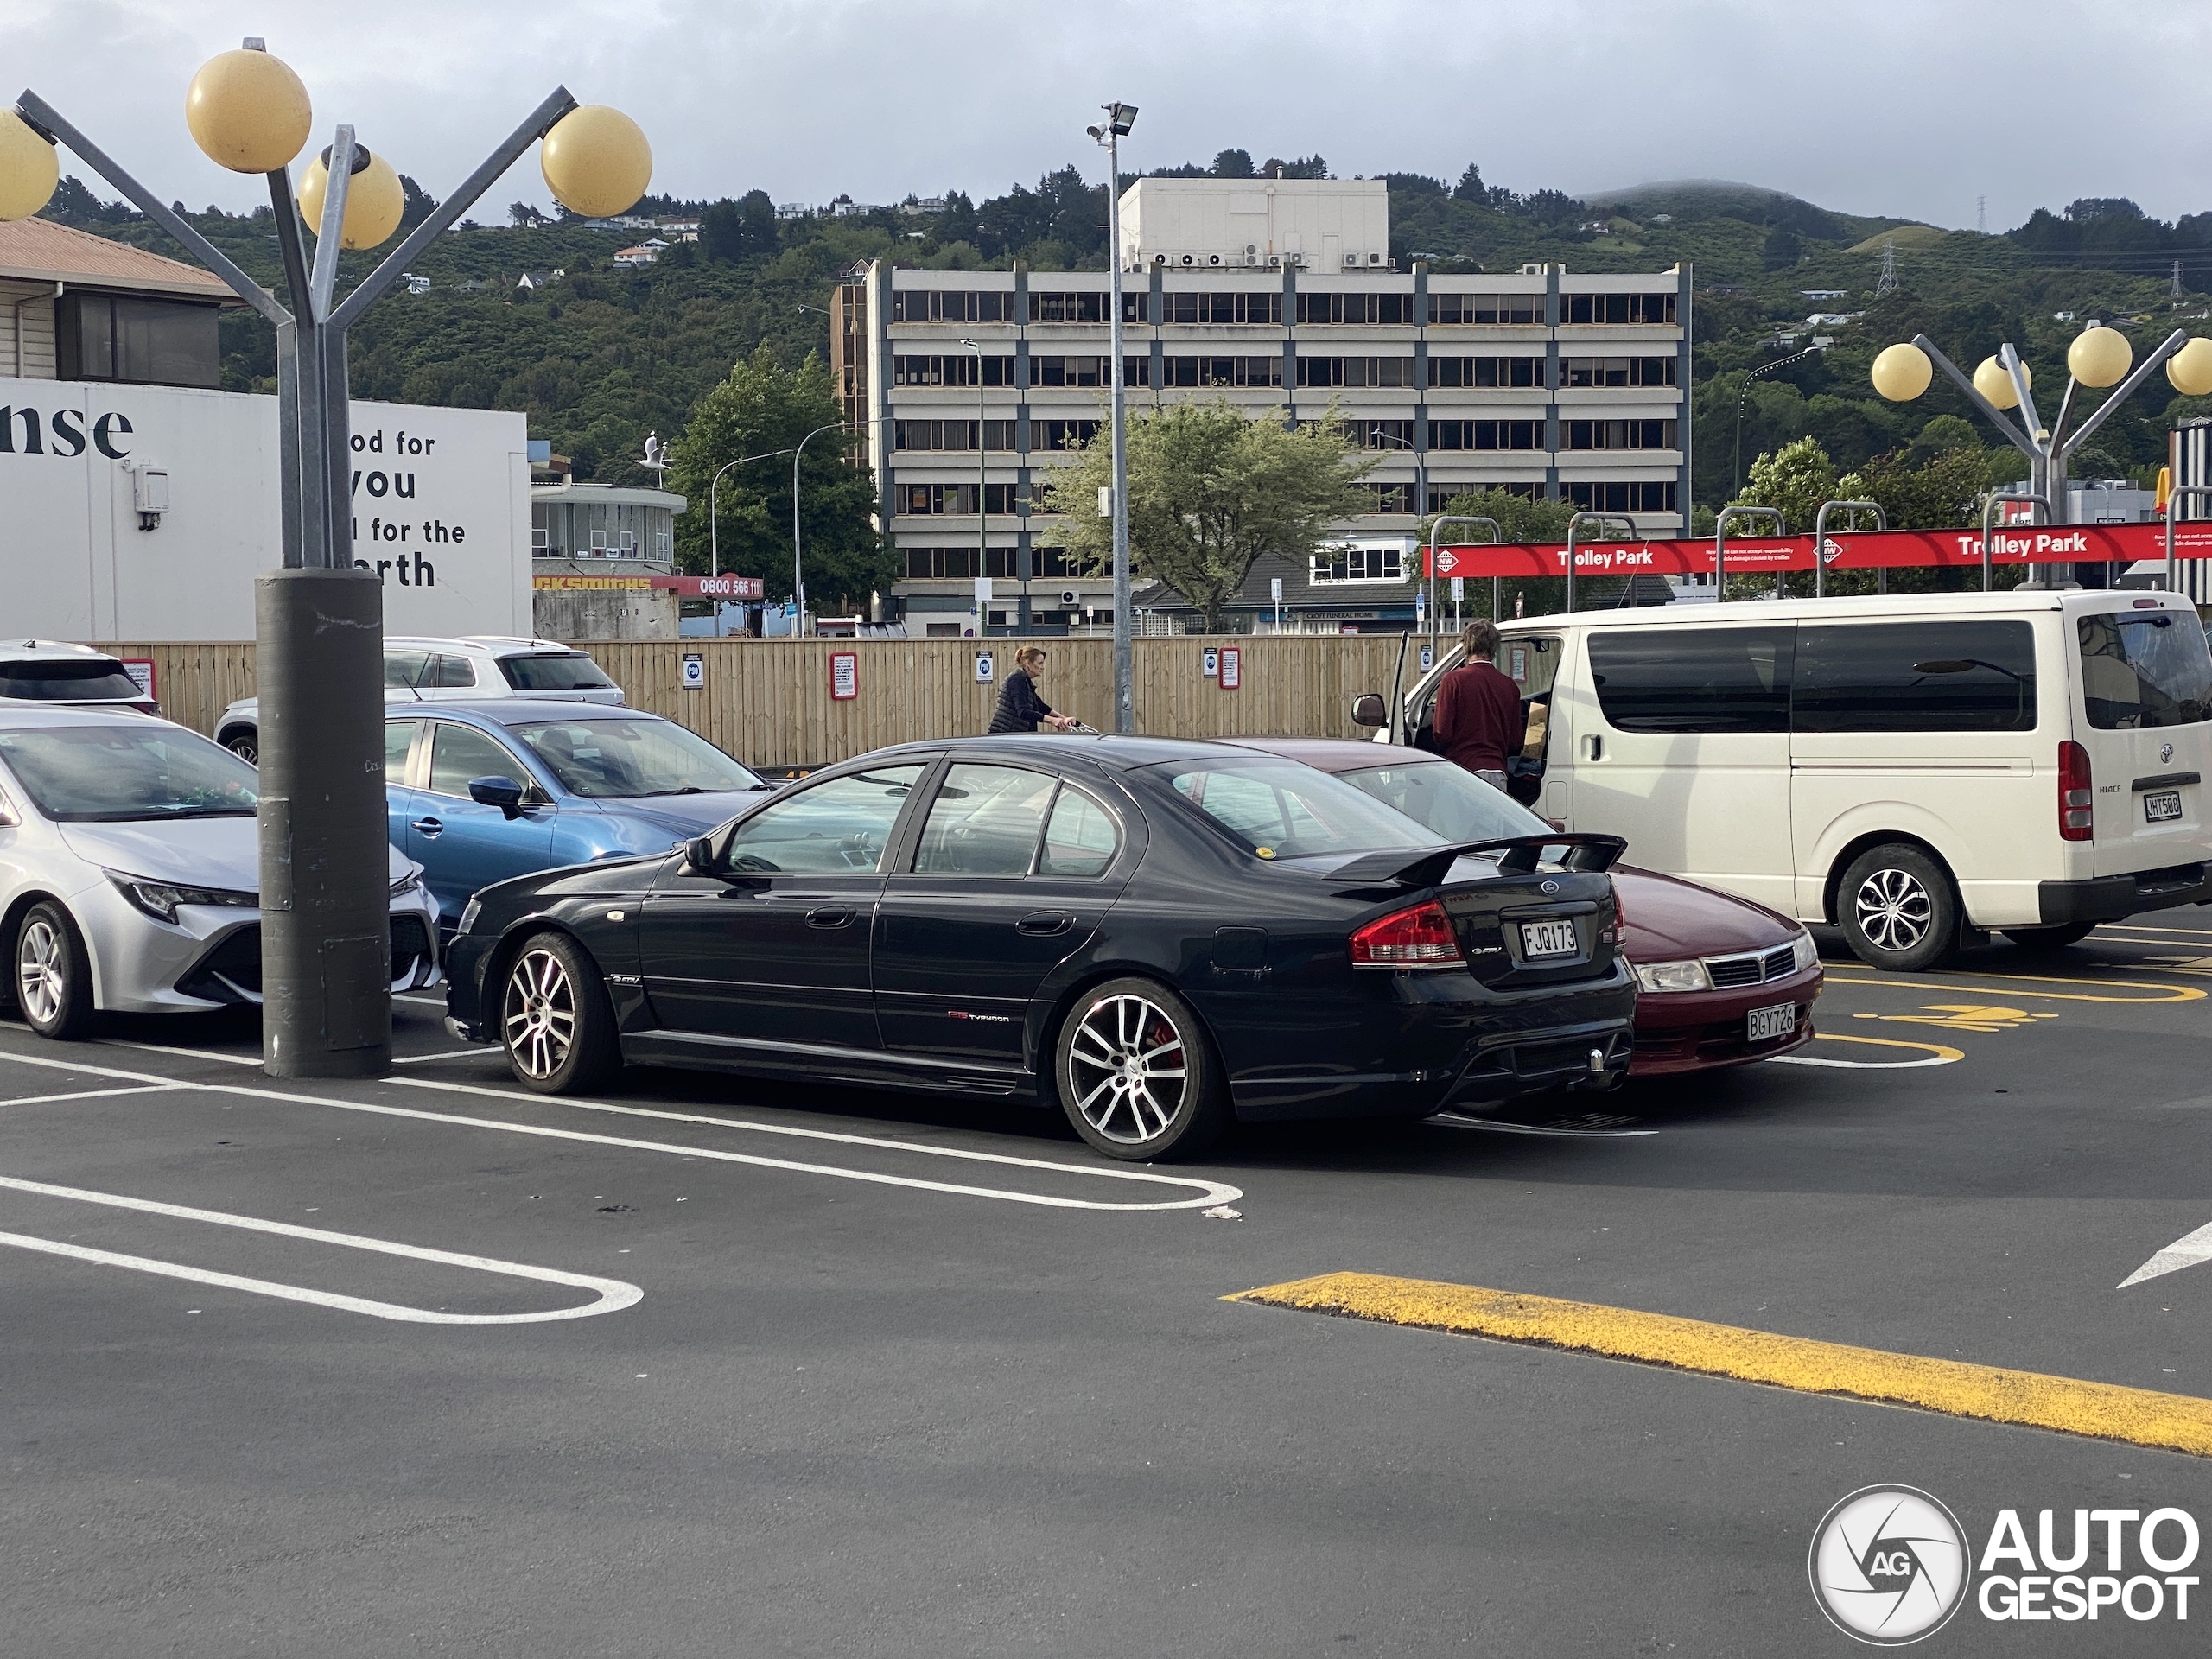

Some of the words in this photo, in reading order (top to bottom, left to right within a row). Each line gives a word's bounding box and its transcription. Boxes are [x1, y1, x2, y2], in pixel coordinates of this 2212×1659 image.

[0, 404, 134, 460] nse
[350, 429, 383, 454] od
[396, 430, 435, 455] for
[371, 517, 411, 542] for
[423, 519, 465, 543] the
[2037, 531, 2088, 553] Park
[1556, 549, 1613, 569] Tolley
[1615, 548, 1654, 565] Park
[699, 579, 730, 594] 0800
[733, 580, 749, 594] 566
[2099, 785, 2122, 794] HIACE
[2148, 797, 2179, 817] JHT508
[1523, 924, 1575, 954] FJQ173
[969, 1014, 1010, 1022] TYPHOON
[1751, 1007, 1794, 1038] BGY726
